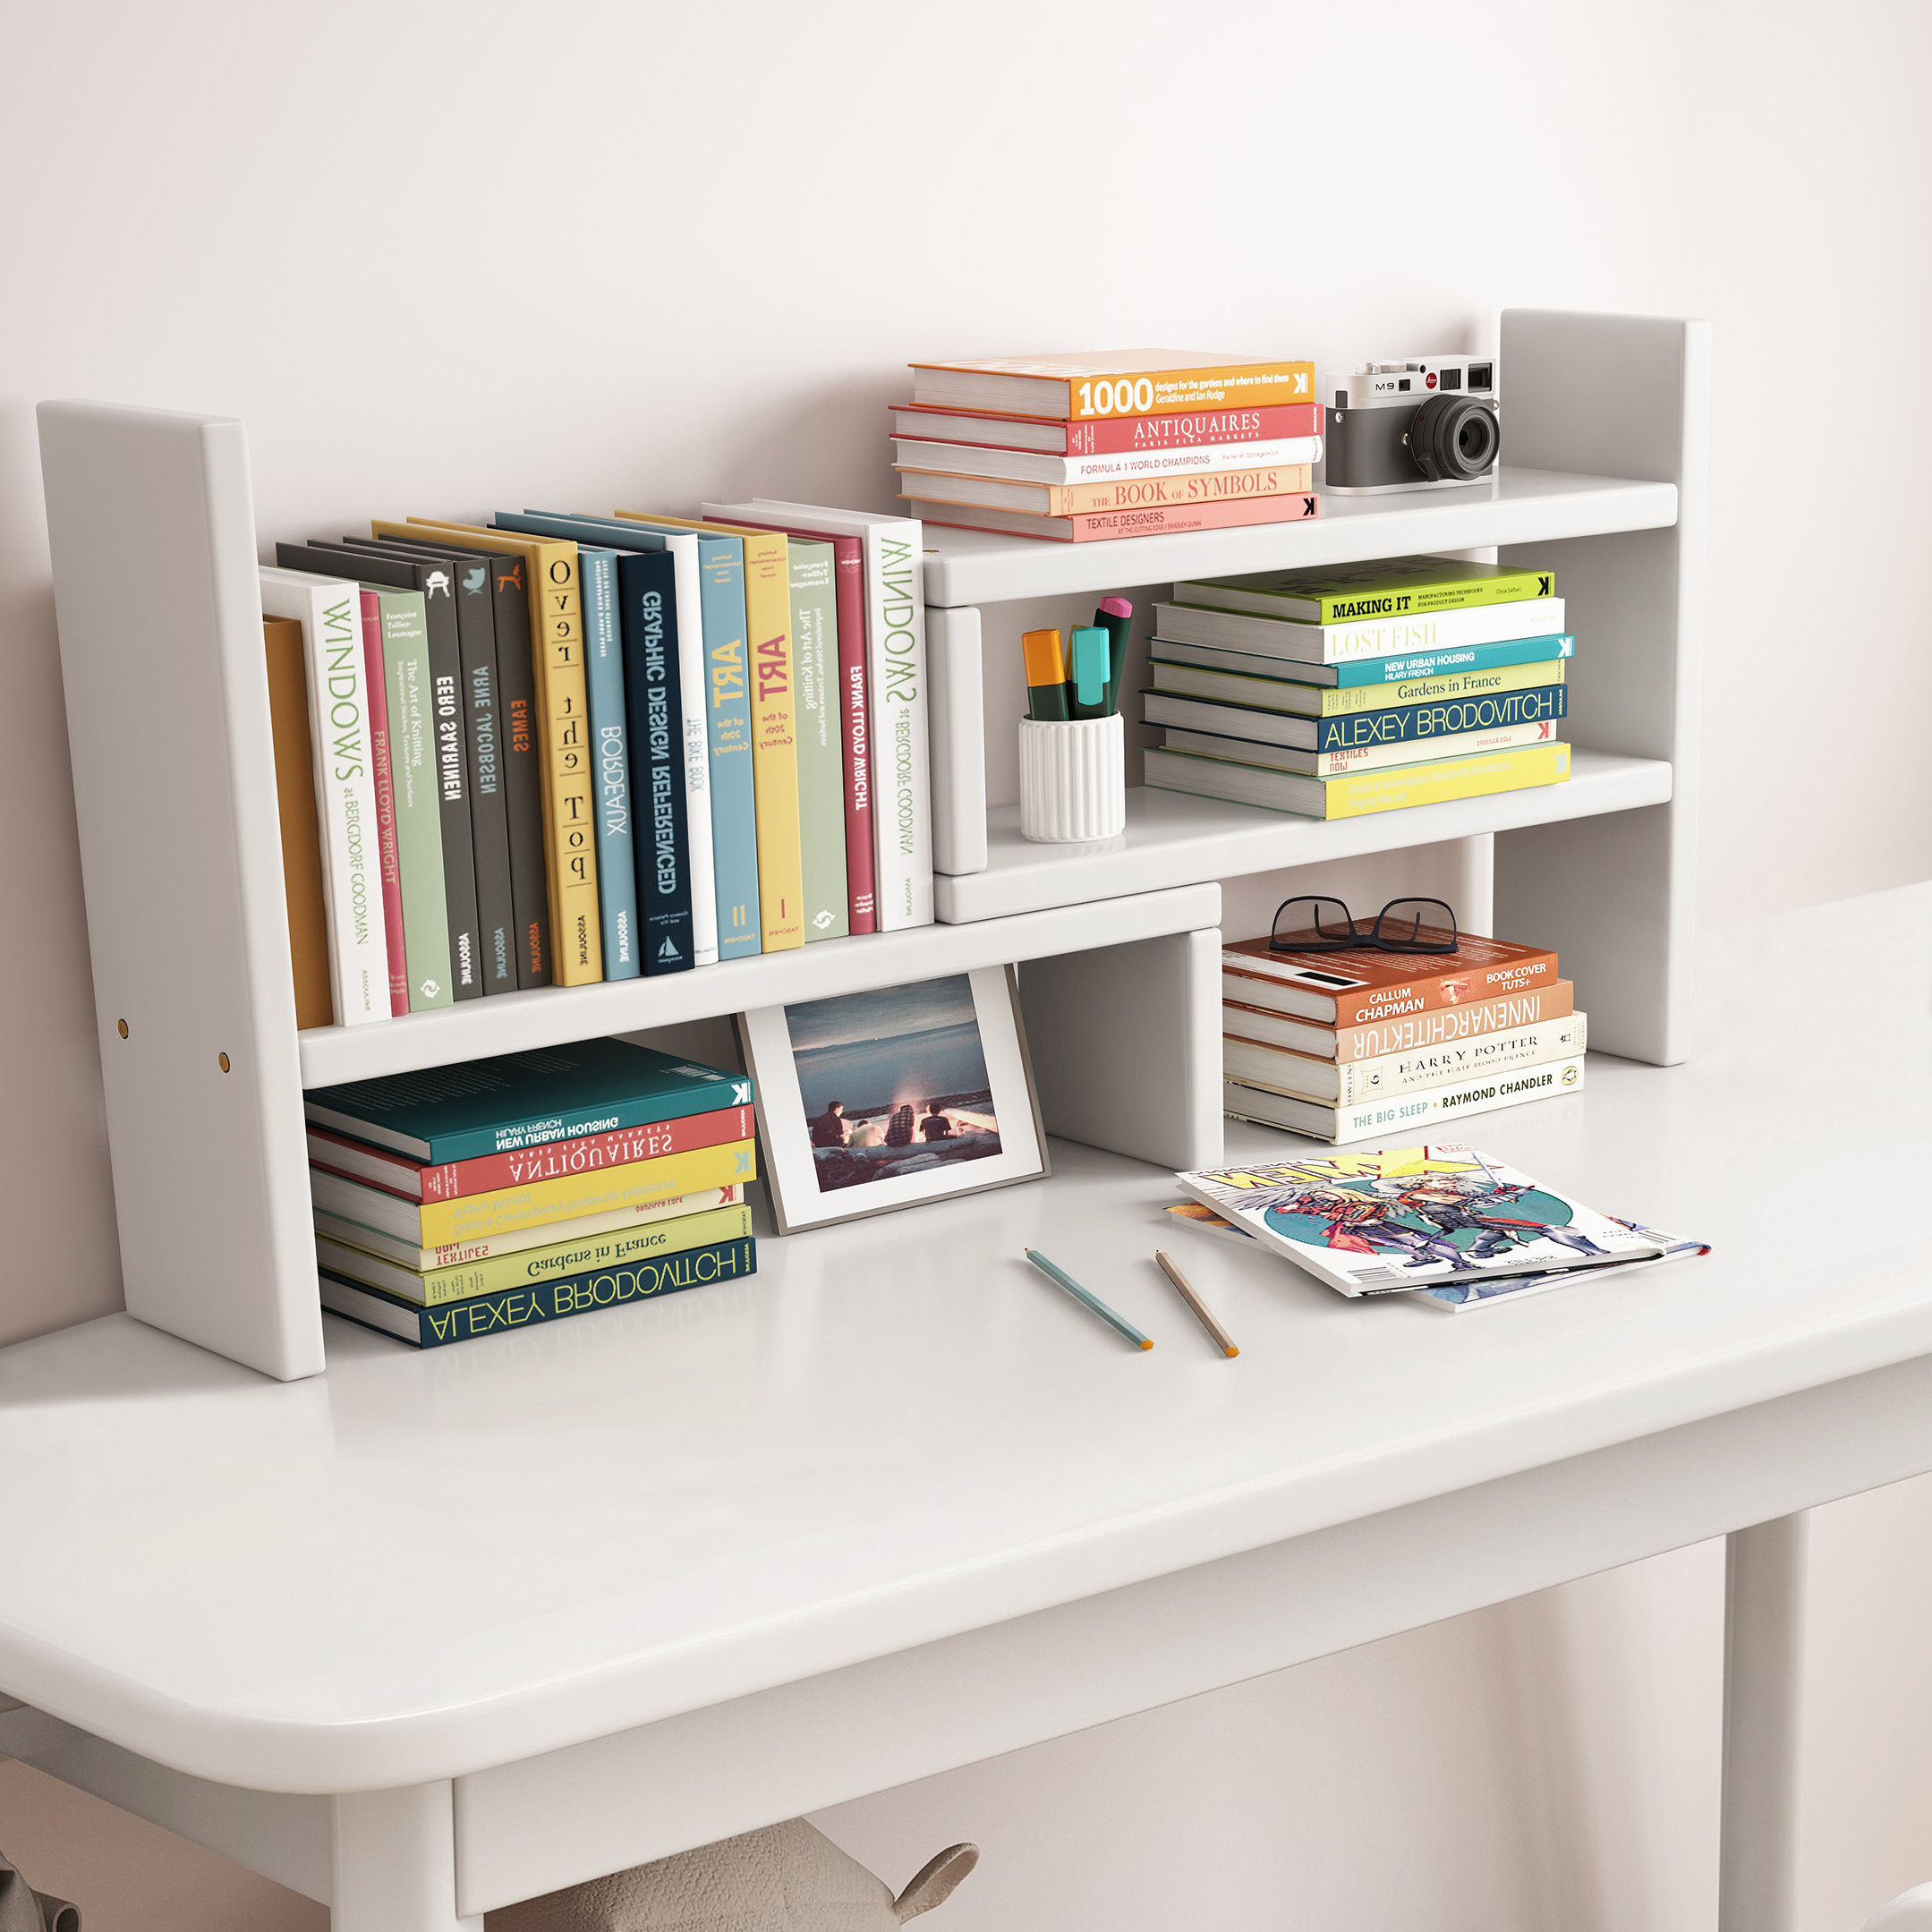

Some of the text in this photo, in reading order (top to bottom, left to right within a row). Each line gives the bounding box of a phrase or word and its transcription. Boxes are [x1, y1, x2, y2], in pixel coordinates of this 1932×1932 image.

[1155, 373, 1289, 393] designs for the gardens and where to find them
[1375, 382, 1395, 391] M9
[1079, 378, 1153, 415] 1000
[1155, 390, 1225, 404] Geraldine and Ian Rudge
[1134, 413, 1260, 439] ANTIQUAIRES
[1135, 431, 1260, 448] PARIS FLEA MARKETS
[1081, 455, 1210, 474] FORMULA 1 WORLD CHAMPIONS
[1092, 496, 1111, 507] THE
[1115, 482, 1167, 506] BOOK
[1171, 491, 1185, 500] OF
[1187, 472, 1278, 498] SYMBOLS
[1086, 511, 1164, 529] TEXTILE DESIGNERS
[1168, 522, 1187, 530] BRADLEY
[1187, 520, 1202, 528] QUINN
[1417, 587, 1483, 600] MANUFACTURING TECHNIQUES
[1427, 599, 1447, 607] PRODUCT
[1448, 597, 1465, 605] DESIGN
[386, 610, 417, 621] Françoise
[1332, 596, 1411, 618] MAKING IT
[387, 629, 422, 639] Loumagne
[1332, 622, 1436, 657] LOST FISH
[1384, 651, 1475, 672] NEW URBAN HOUSING
[1385, 668, 1434, 680] HILARY FRENCH
[1398, 675, 1501, 699] Gardens in France
[406, 659, 423, 767] The Art of Knitting
[1325, 693, 1553, 749] ALEXEY BRODOVITCH
[1500, 736, 1512, 744] COLE
[1330, 748, 1368, 762] TEXTILES
[323, 599, 369, 945] WINDOWS at BERGDORF GOODMAN
[374, 730, 396, 884] FRANK LLOYD WRIGHT
[1486, 963, 1546, 984] BOOK COVER
[1501, 977, 1531, 992] TUTS+
[1369, 987, 1411, 1005] CALLUM
[1355, 998, 1426, 1023] CHAPMAN
[1353, 1003, 1541, 1060] INNENARCHITEKTUR
[1399, 1036, 1538, 1073] HARRY POTTER
[1401, 1050, 1536, 1084] AND THE HALF BLOOD PRINCE
[1442, 1074, 1553, 1109] RAYMOND CHANDLER
[1353, 1102, 1428, 1128] THE BIG SLEEP
